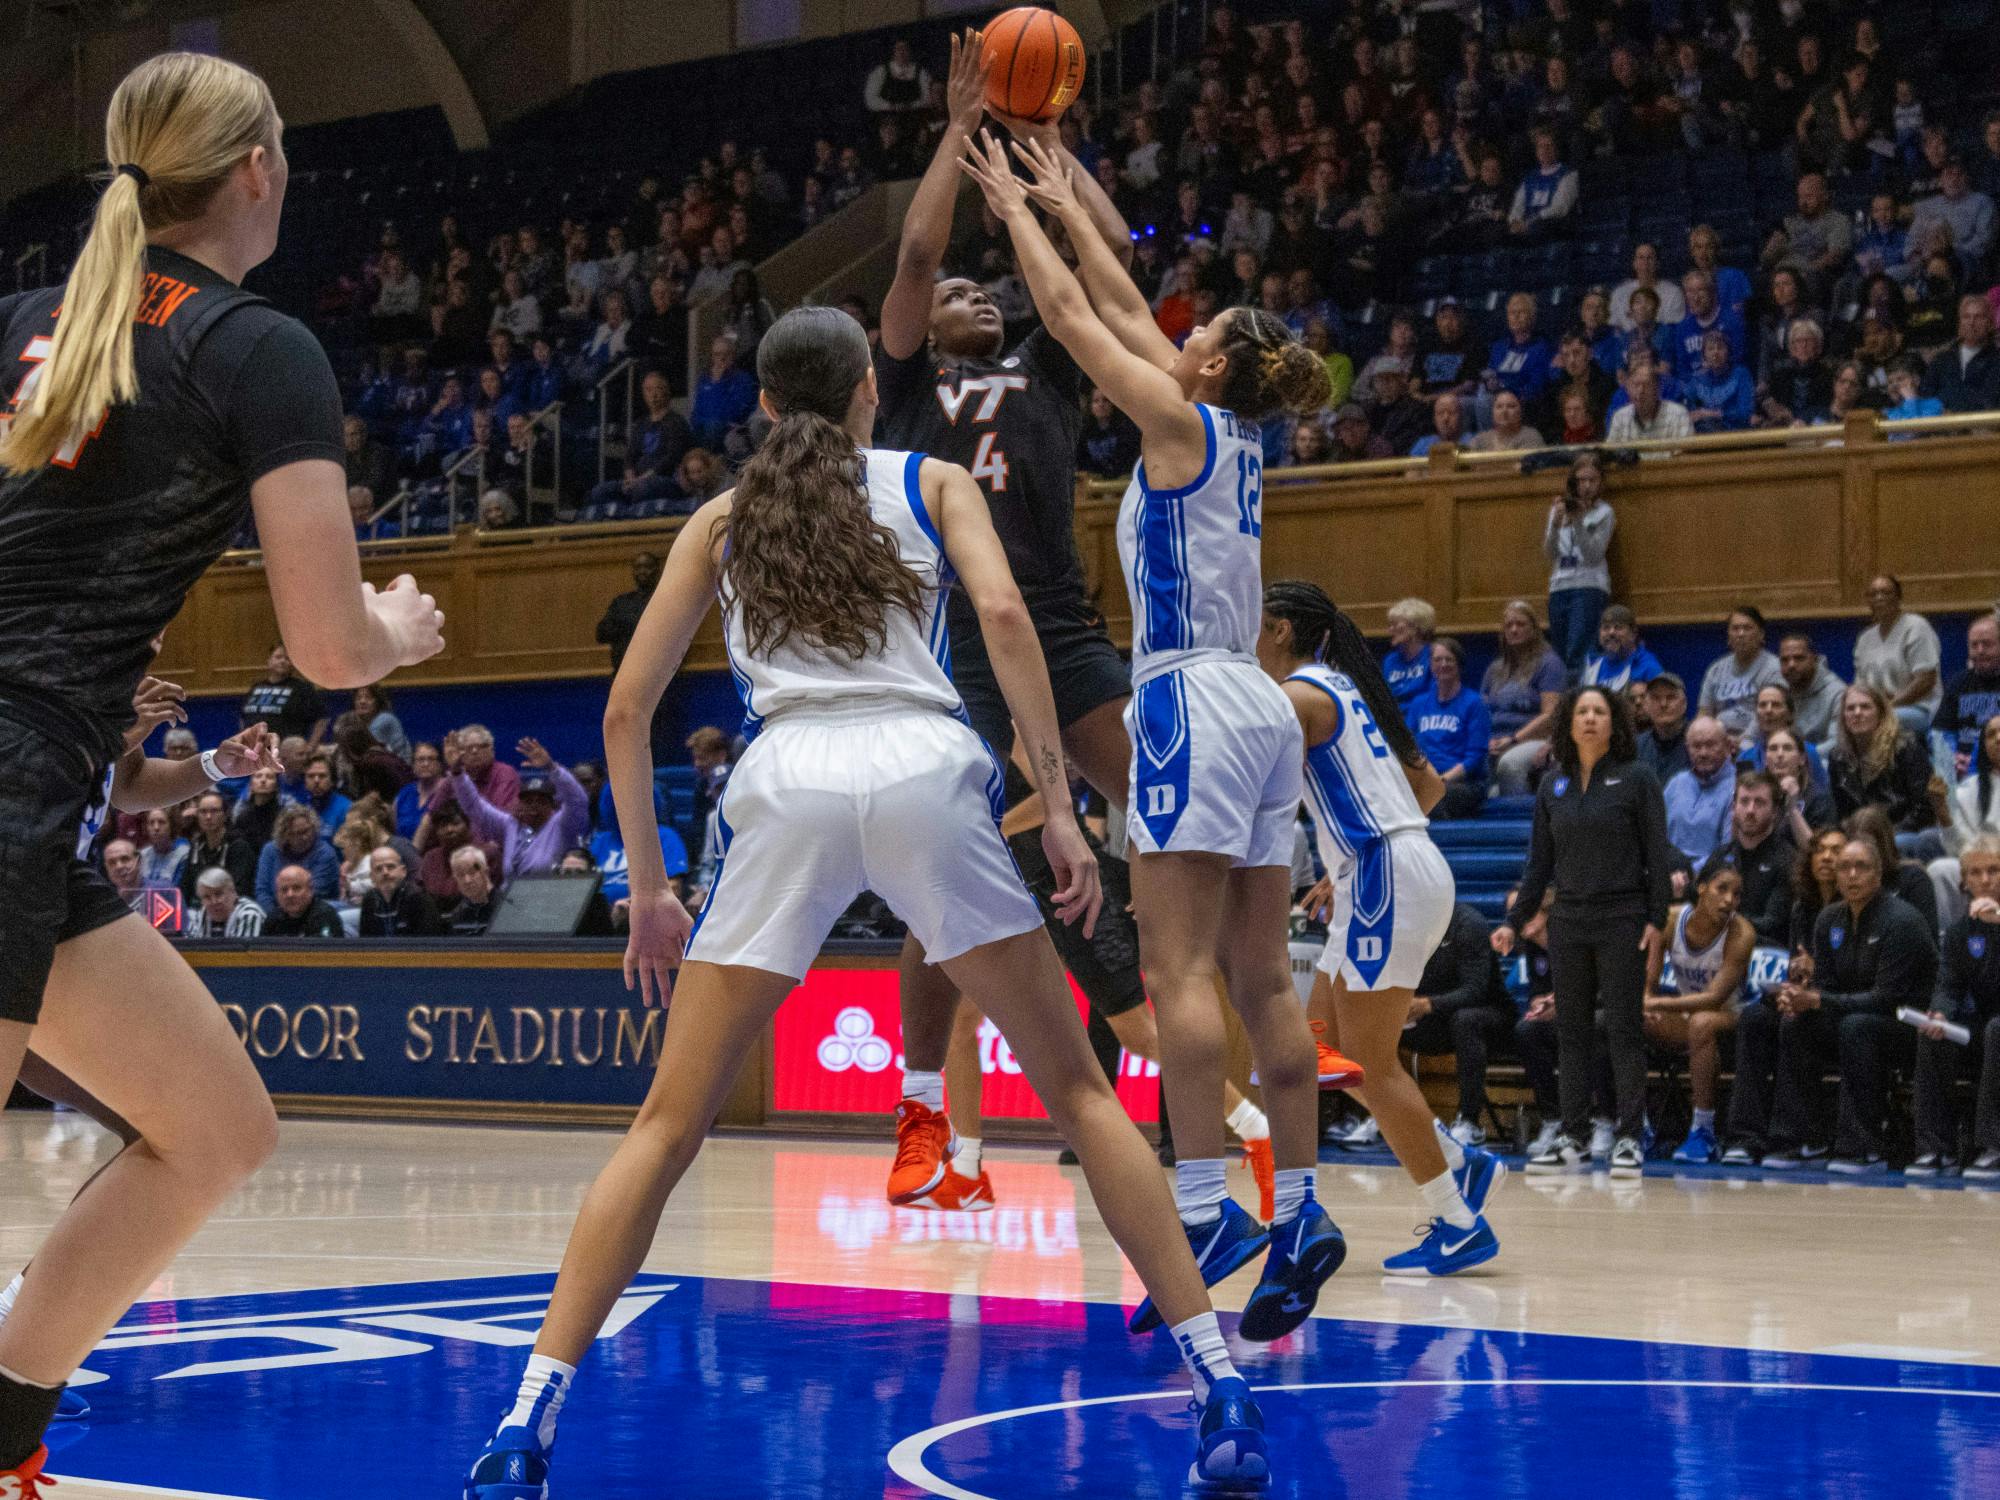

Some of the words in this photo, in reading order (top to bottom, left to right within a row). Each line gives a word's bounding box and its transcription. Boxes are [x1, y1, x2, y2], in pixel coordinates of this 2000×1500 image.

[936, 373, 1028, 427] VT
[971, 431, 1010, 492] 4
[1237, 449, 1262, 540] 12
[1419, 714, 1461, 733] DUKE
[1145, 783, 1176, 818] D
[1355, 936, 1383, 962] D
[405, 1005, 662, 1066] STADIUM
